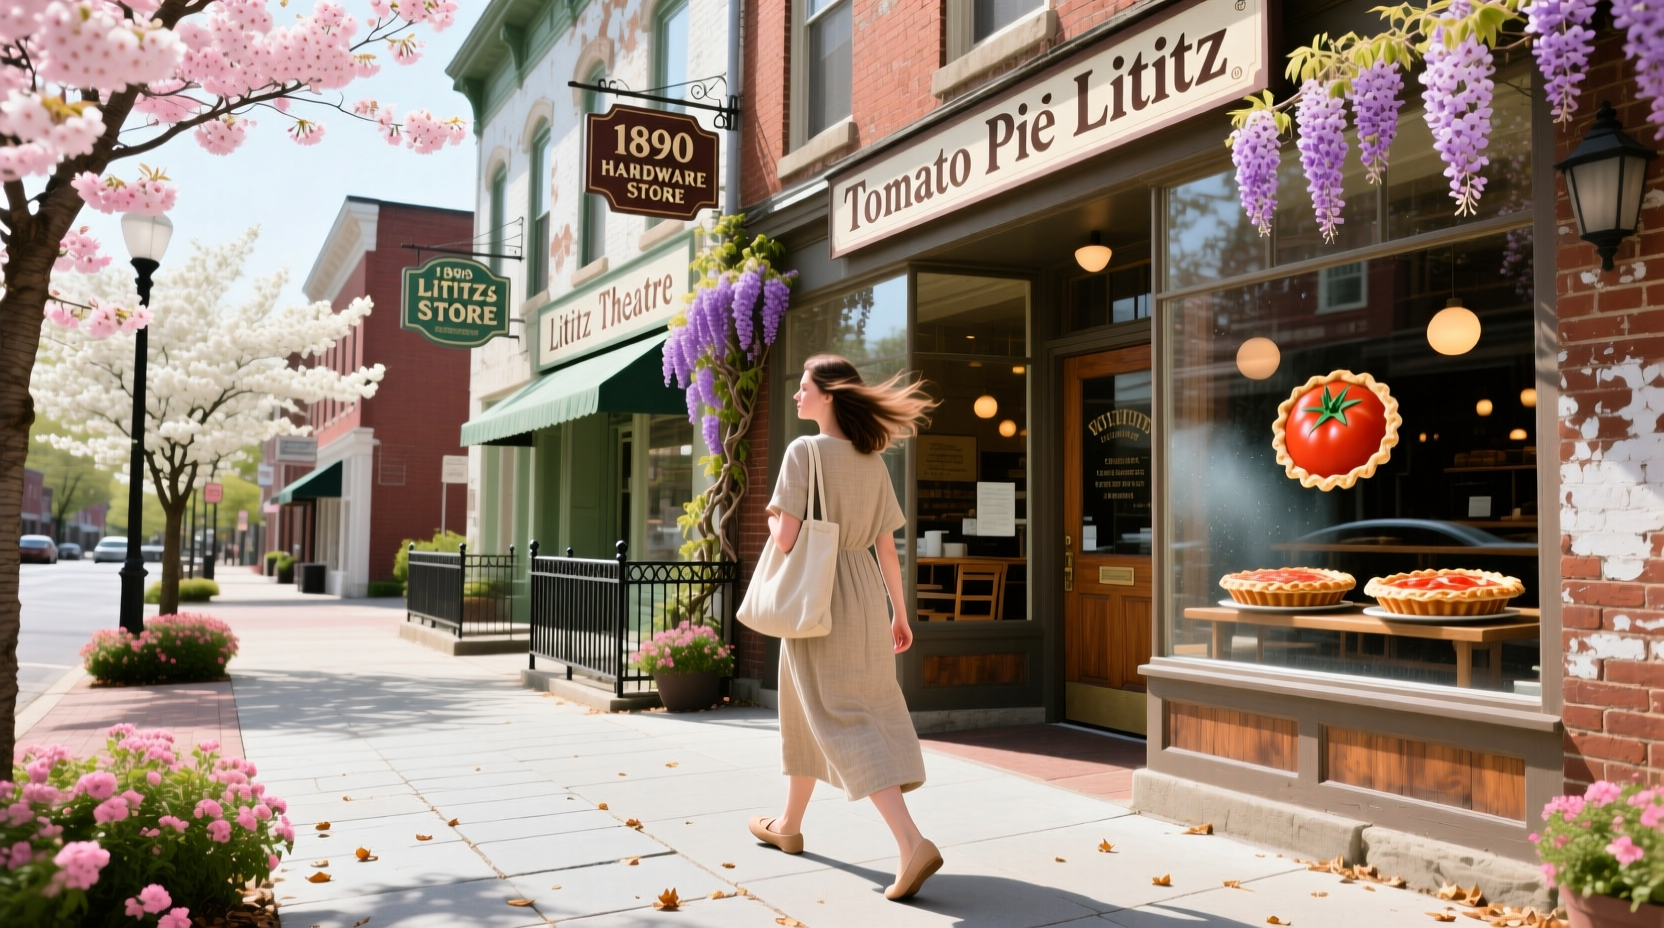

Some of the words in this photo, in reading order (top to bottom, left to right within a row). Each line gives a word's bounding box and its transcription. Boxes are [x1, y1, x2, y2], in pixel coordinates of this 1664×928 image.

[614, 124, 693, 163] 1890
[844, 148, 971, 232] Tomato
[1073, 28, 1227, 137] Lititz
[601, 159, 706, 188] HARDWARE
[627, 182, 685, 204] STORE
[418, 300, 497, 325] STORE
[549, 309, 591, 352] Lititz
[599, 273, 673, 331] Theatre
